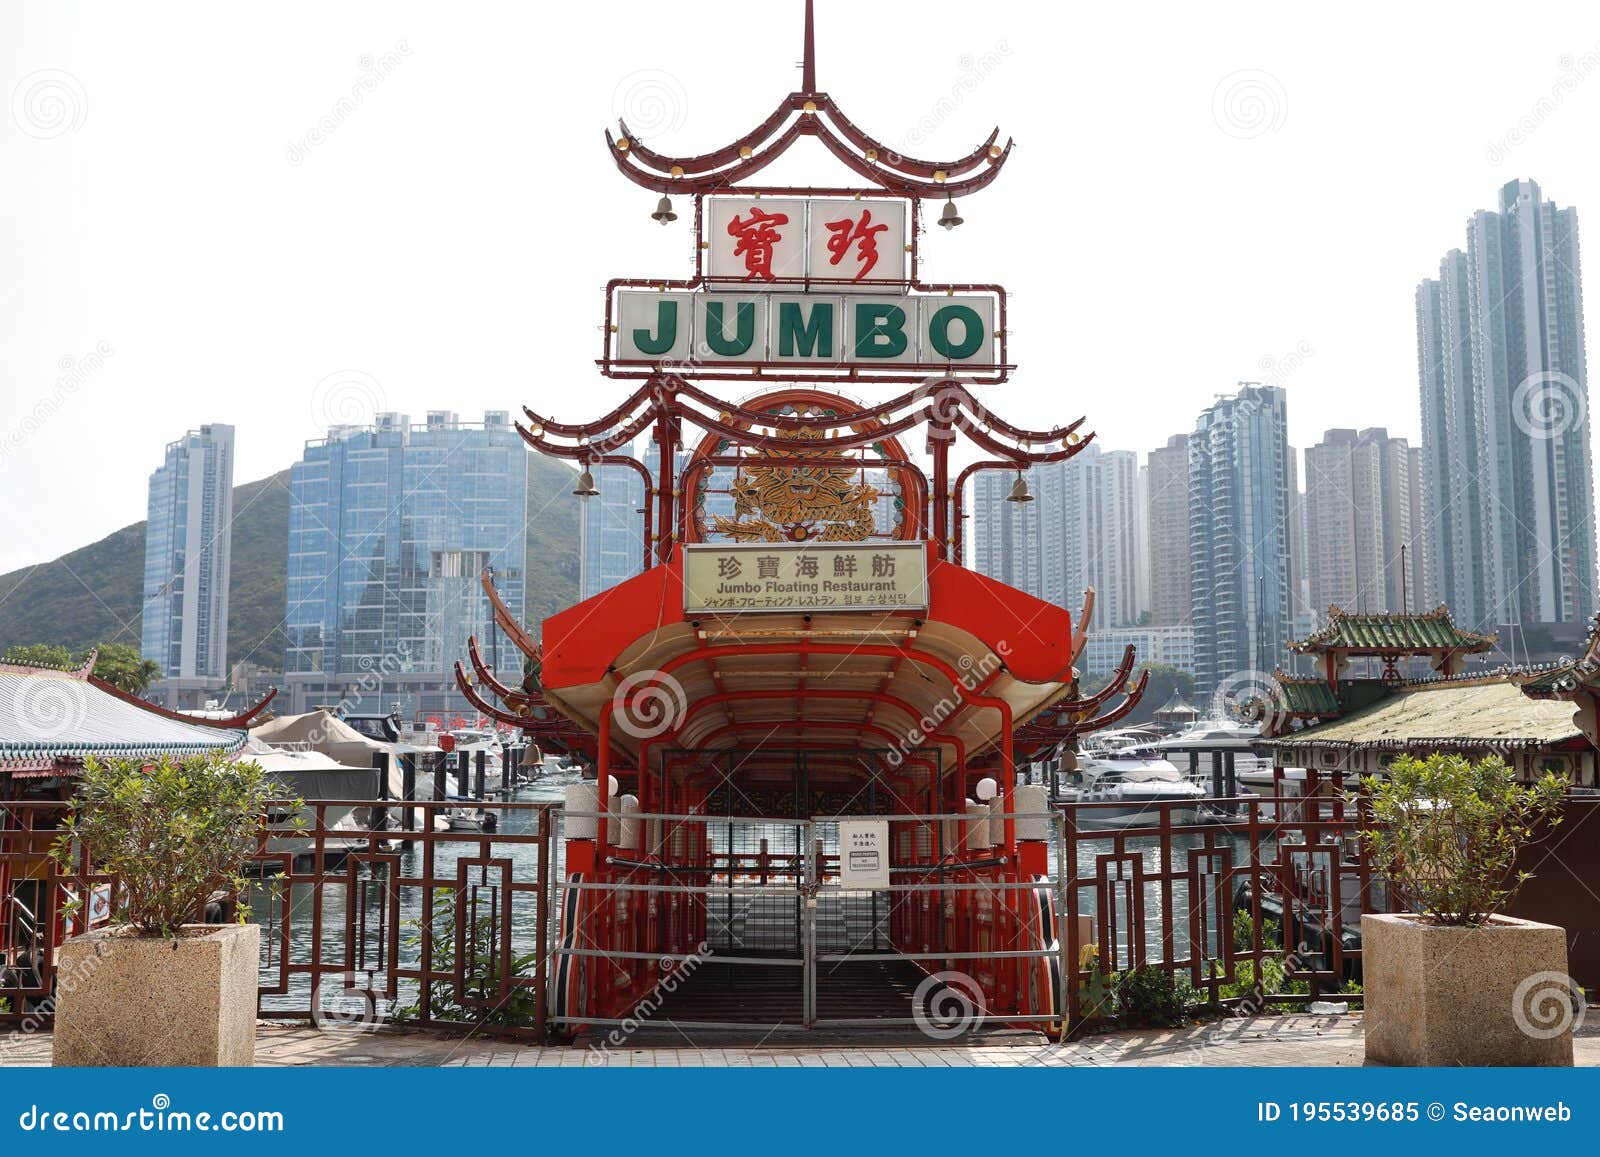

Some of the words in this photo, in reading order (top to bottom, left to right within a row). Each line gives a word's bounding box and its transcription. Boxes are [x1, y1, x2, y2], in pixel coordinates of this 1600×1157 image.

[632, 299, 985, 361] JUMBO
[717, 553, 898, 580] 珍寶海鮮舫
[715, 581, 762, 595] Jumbo
[765, 580, 818, 595] Floating
[822, 579, 898, 593] Restaurant
